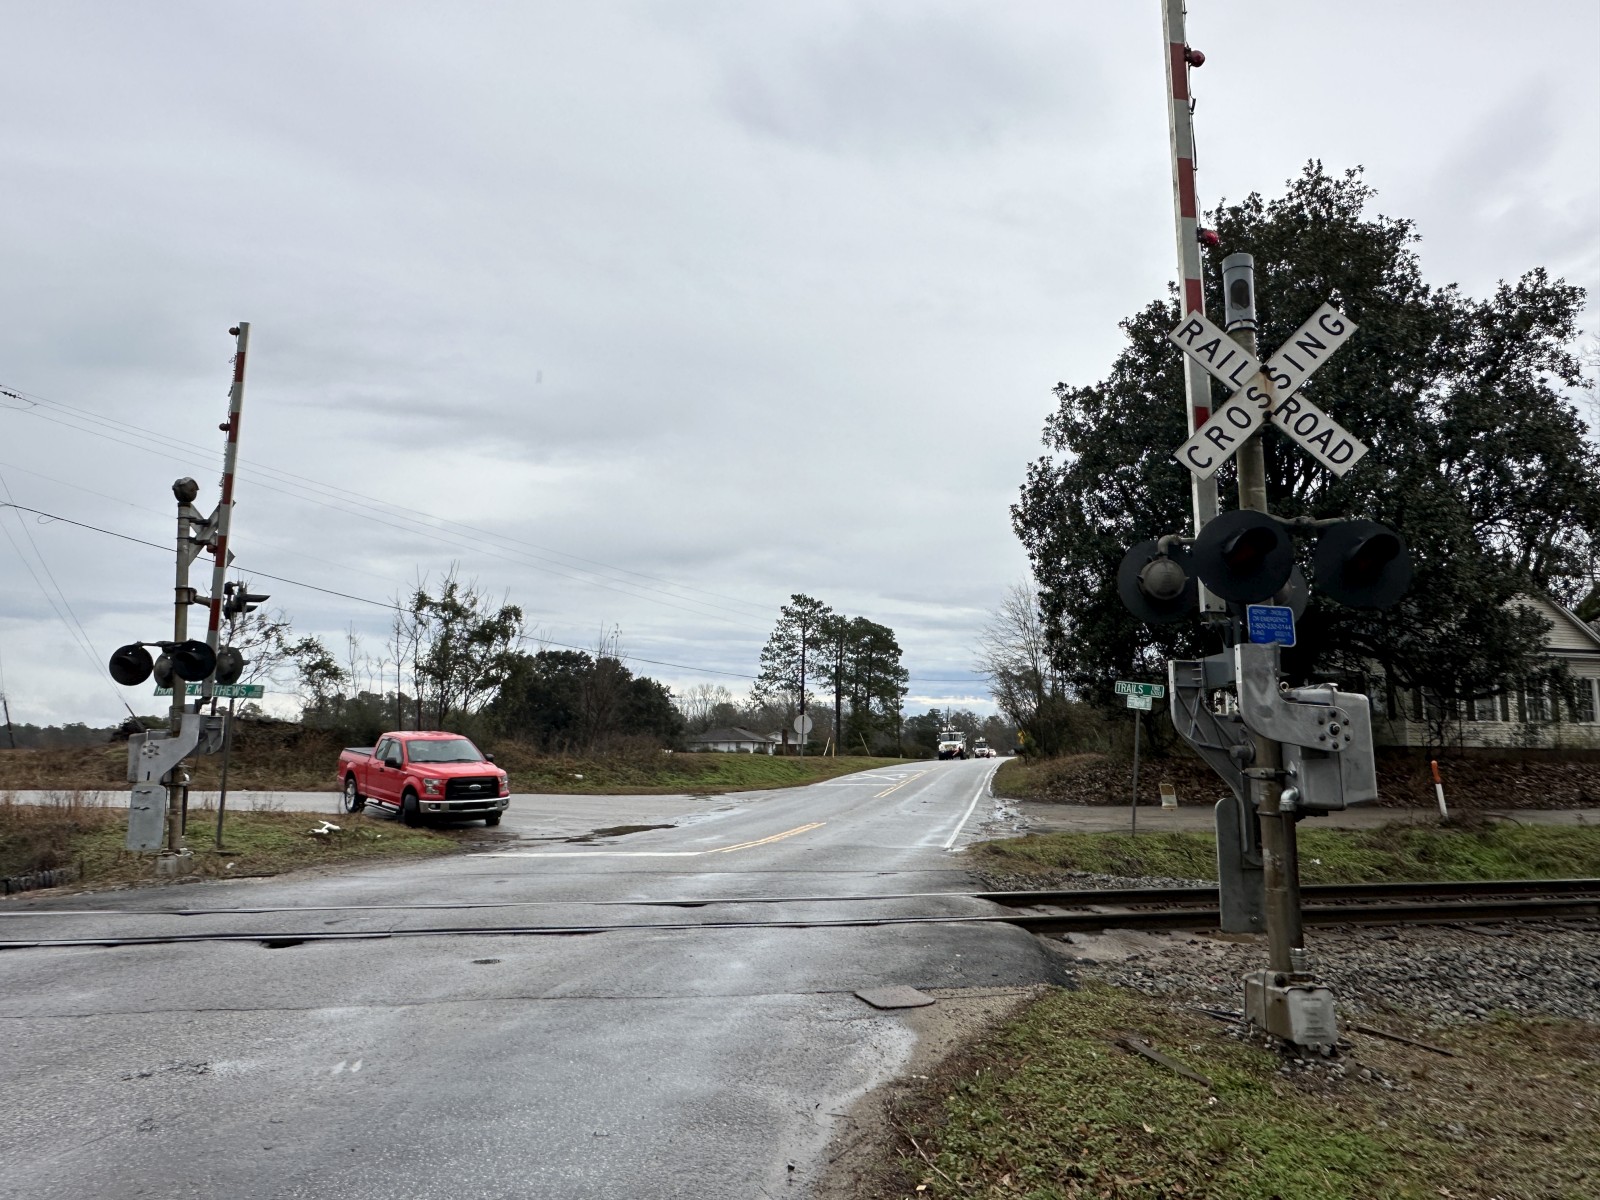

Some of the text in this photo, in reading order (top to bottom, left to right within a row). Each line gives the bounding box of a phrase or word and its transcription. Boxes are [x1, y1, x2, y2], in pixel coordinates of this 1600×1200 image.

[1177, 318, 1354, 465] RAIL ROAD
[1187, 313, 1345, 469] CROSSING
[1116, 682, 1144, 694] TRAILS
